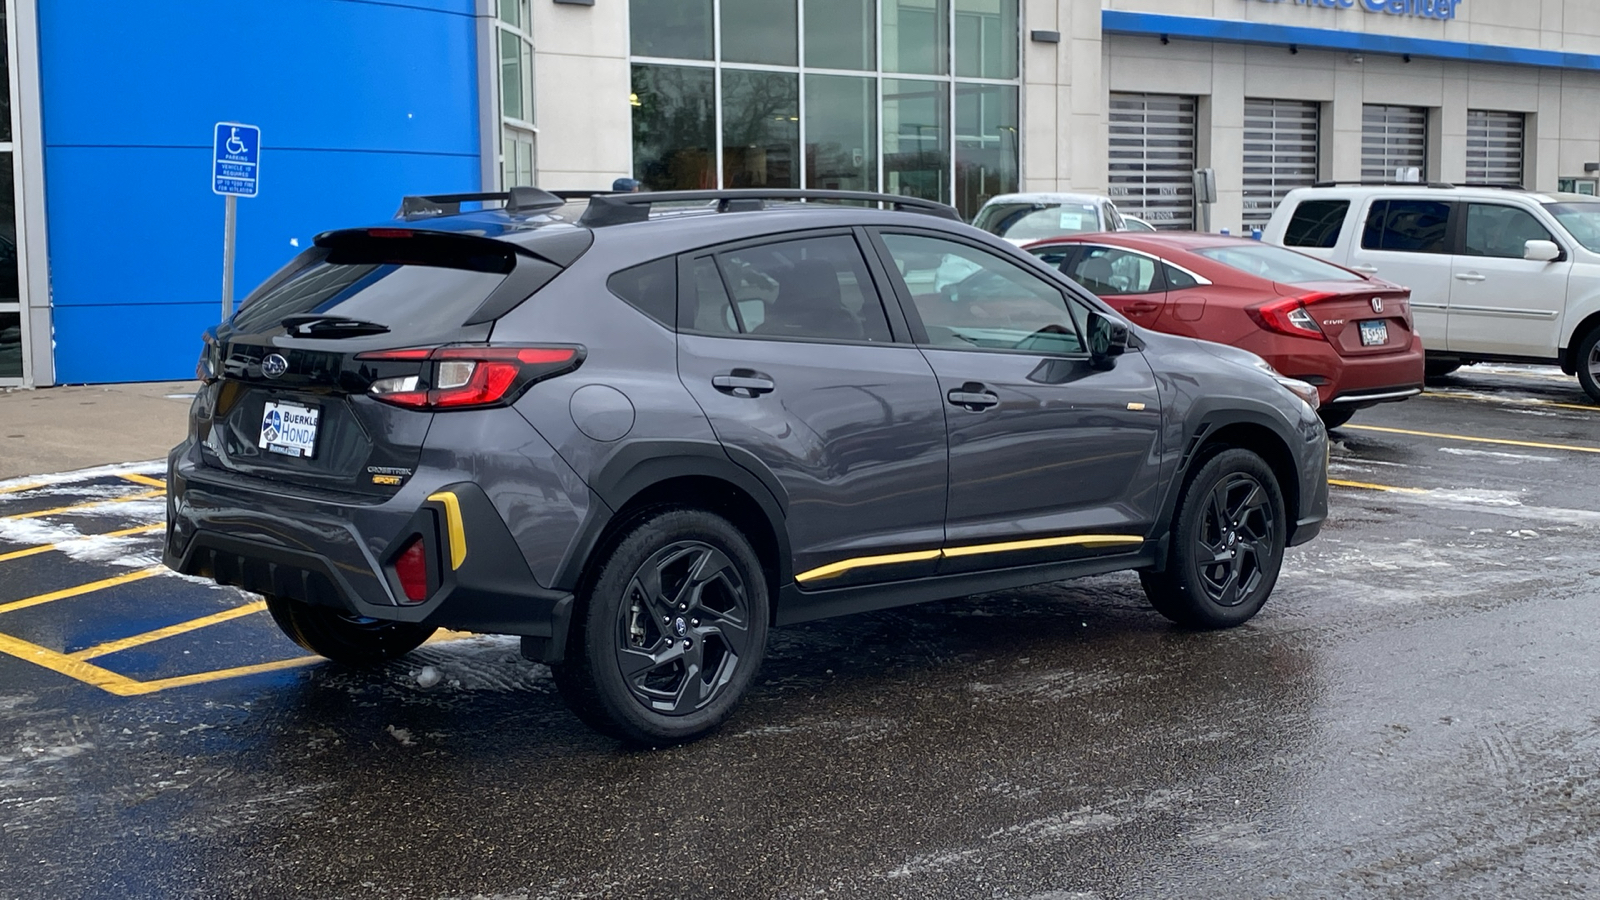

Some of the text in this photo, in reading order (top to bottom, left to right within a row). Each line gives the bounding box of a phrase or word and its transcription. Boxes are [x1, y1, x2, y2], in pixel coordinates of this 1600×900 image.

[284, 411, 318, 427] BUERKLE
[367, 466, 412, 476] CROSSTREK
[372, 475, 402, 485] SPORT
